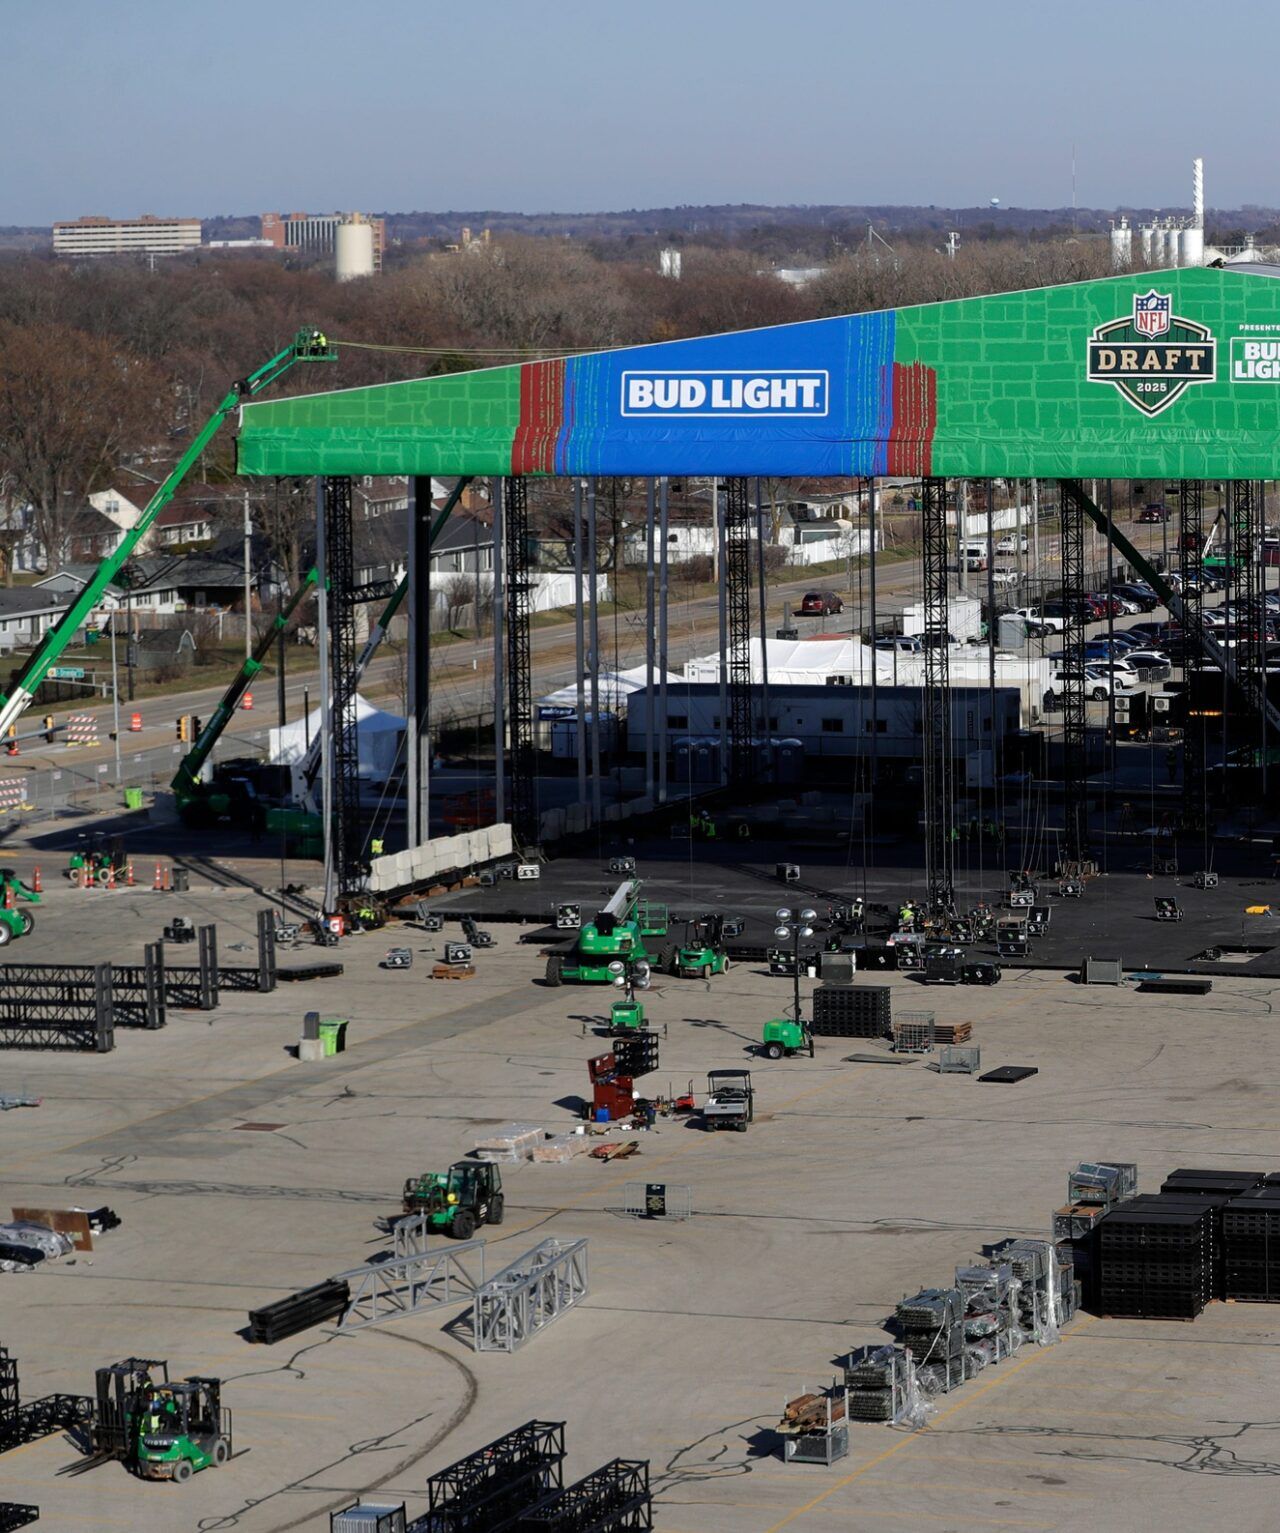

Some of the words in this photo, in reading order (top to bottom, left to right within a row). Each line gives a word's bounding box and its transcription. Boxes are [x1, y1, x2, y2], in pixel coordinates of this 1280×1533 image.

[1139, 311, 1166, 331] NFL
[1098, 349, 1205, 371] DRAFT
[628, 379, 706, 409] BUD
[711, 378, 821, 409] LIGHT
[1136, 383, 1167, 392] 2025
